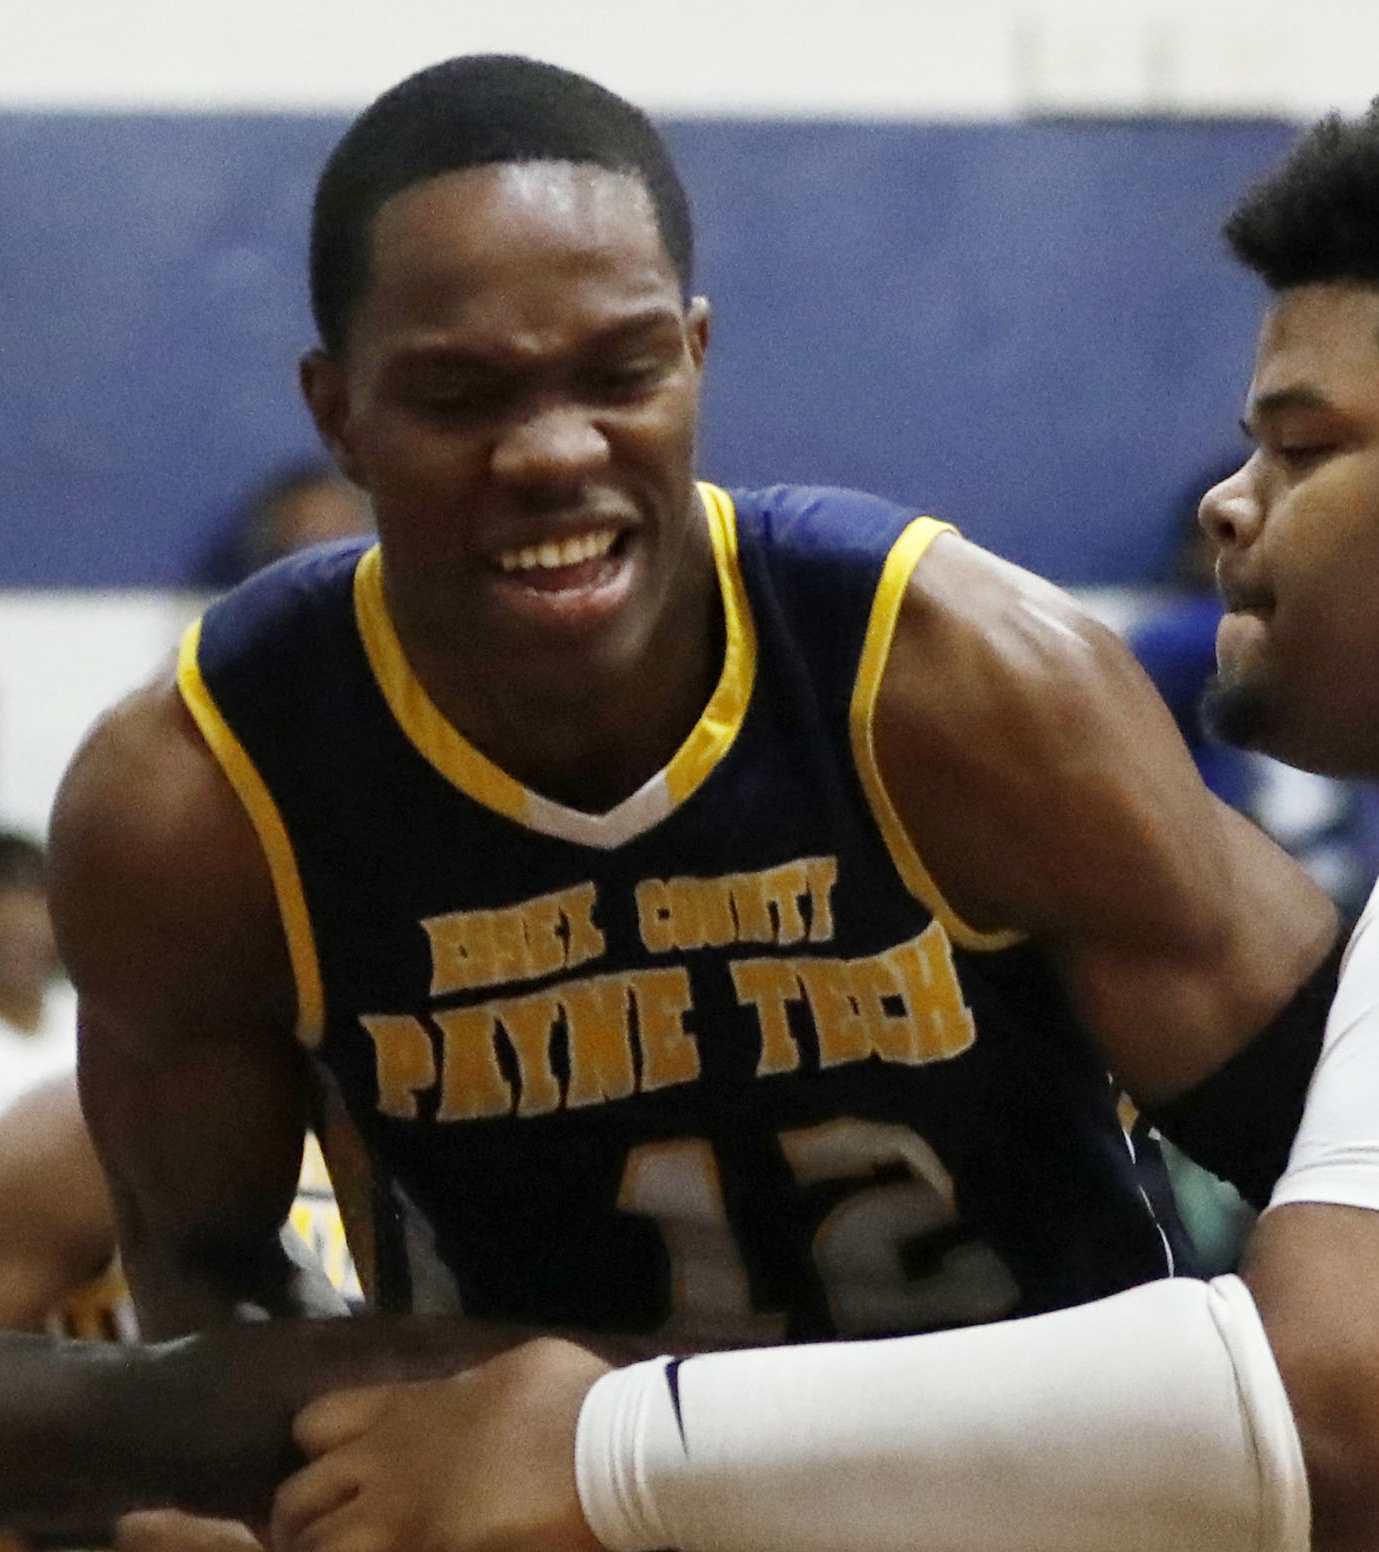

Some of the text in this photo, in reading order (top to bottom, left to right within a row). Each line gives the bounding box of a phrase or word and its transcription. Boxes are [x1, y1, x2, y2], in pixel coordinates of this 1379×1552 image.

[633, 854, 839, 955] COUNTY
[357, 918, 978, 1124] PAYNE TECH
[615, 1115, 1022, 1348] 12
